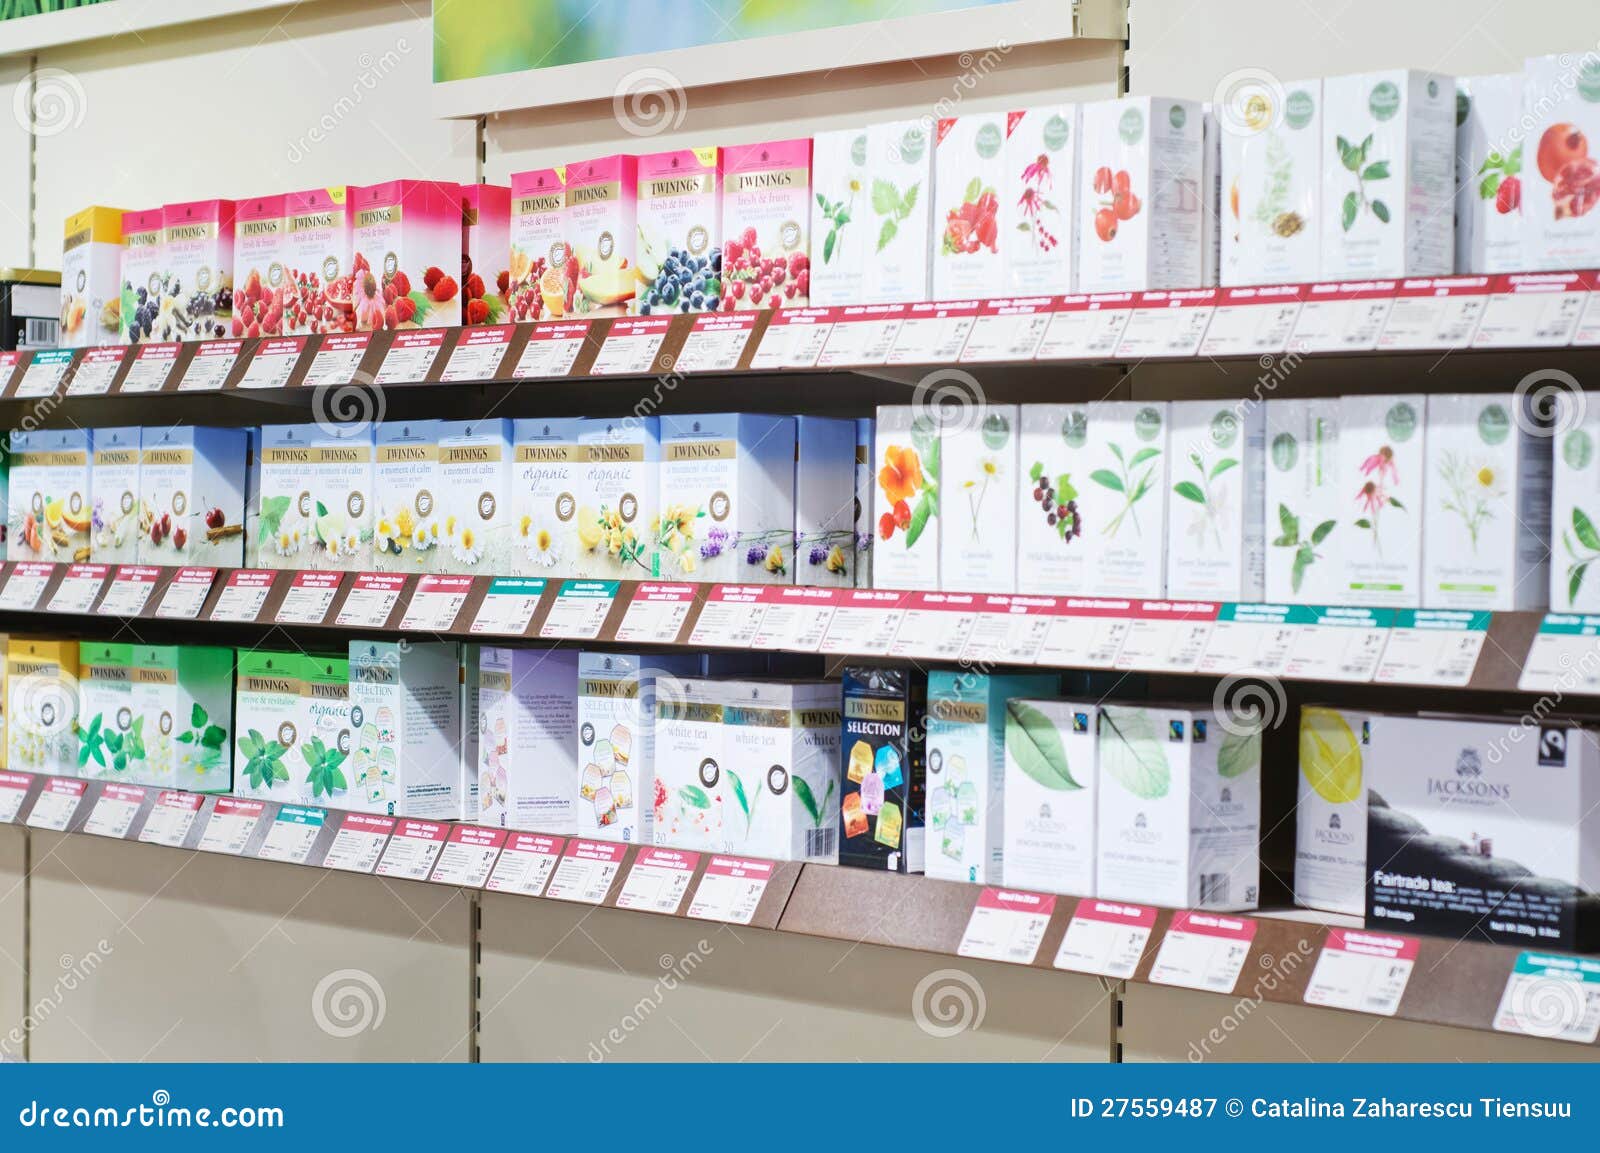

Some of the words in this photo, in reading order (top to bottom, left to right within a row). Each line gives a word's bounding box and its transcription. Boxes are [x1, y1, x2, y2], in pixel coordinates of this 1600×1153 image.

[700, 152, 713, 161] NEW
[652, 179, 699, 195] TWININGS
[739, 173, 792, 189] TWININGS
[574, 187, 608, 202] TWININGS
[521, 197, 560, 212] TWININGS
[294, 214, 332, 230] TWININGS
[361, 210, 391, 224] TWININGS
[171, 227, 205, 240] TWININGS
[243, 222, 277, 234] TWININGS
[150, 453, 182, 463] TWININGS
[272, 450, 308, 461] TWININGS
[320, 449, 357, 461] TWININGS
[387, 448, 425, 460] TWININGS
[449, 447, 488, 461] TWININGS
[524, 448, 567, 460] TWININGS
[588, 447, 630, 460] TWININGS
[673, 443, 720, 459] TWININGS
[523, 467, 568, 492] organic
[90, 668, 126, 681] TWININGS
[248, 678, 289, 691] TWININGS
[311, 684, 348, 698] TWININGS
[585, 680, 632, 697] TWININGS
[851, 701, 899, 716] TWININGS
[801, 711, 841, 727] TWININ
[667, 726, 692, 738] white
[847, 721, 900, 737] SELECTION
[804, 733, 836, 747] white
[1426, 777, 1510, 799] JACKSONS
[1373, 870, 1430, 892] Fairtrade
